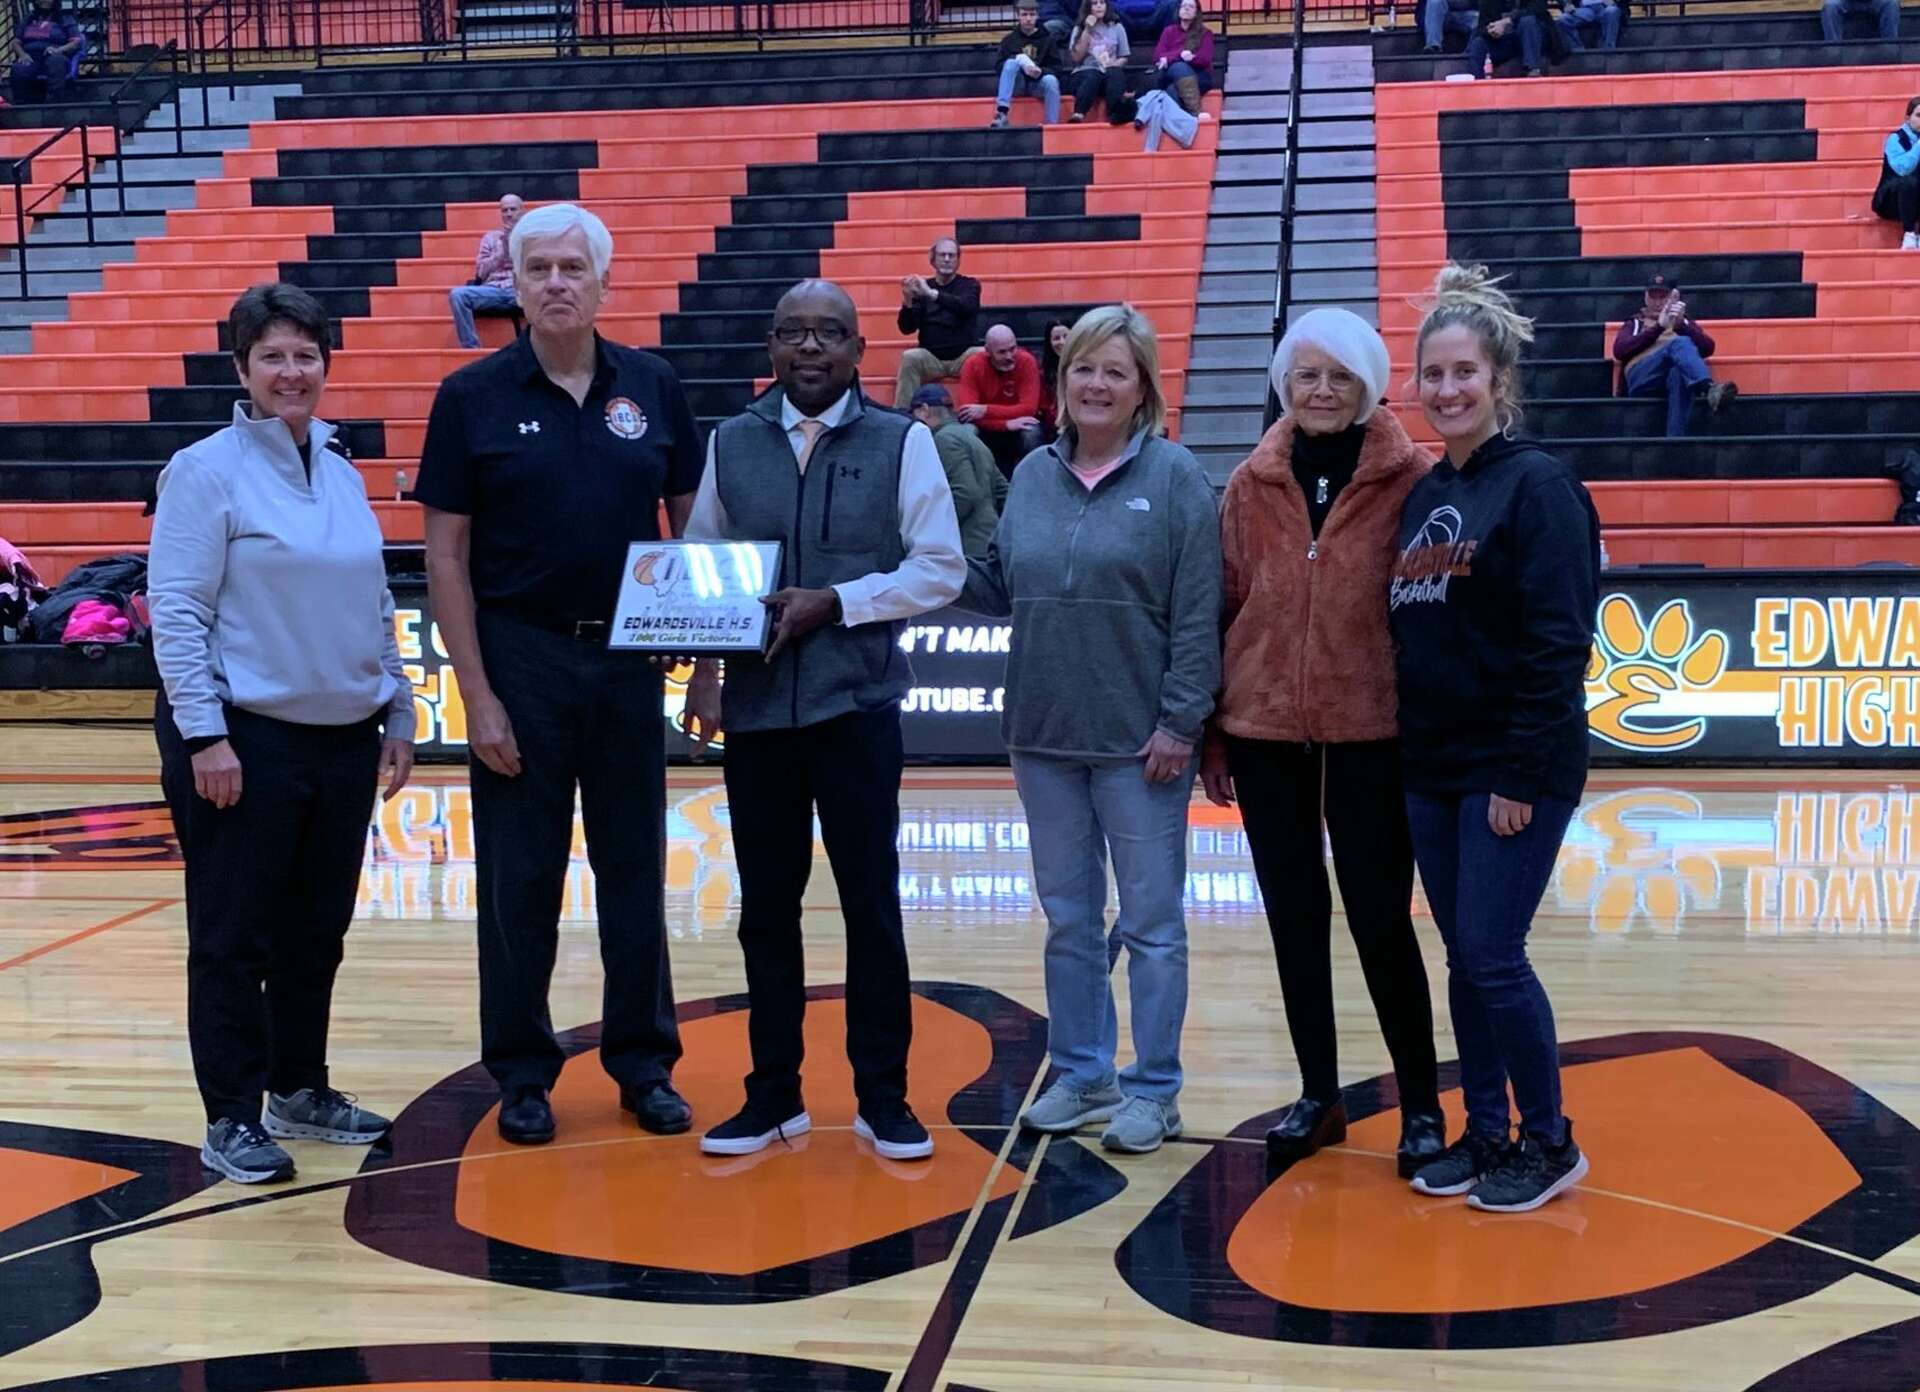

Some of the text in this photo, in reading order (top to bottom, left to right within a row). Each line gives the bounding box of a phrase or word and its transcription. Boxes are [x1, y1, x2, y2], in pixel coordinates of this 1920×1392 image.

[623, 616, 753, 630] EDWARDSVILLE H.S.
[658, 633, 687, 643] Girls
[691, 633, 742, 643] Victories
[1776, 676, 1920, 747] HIGH
